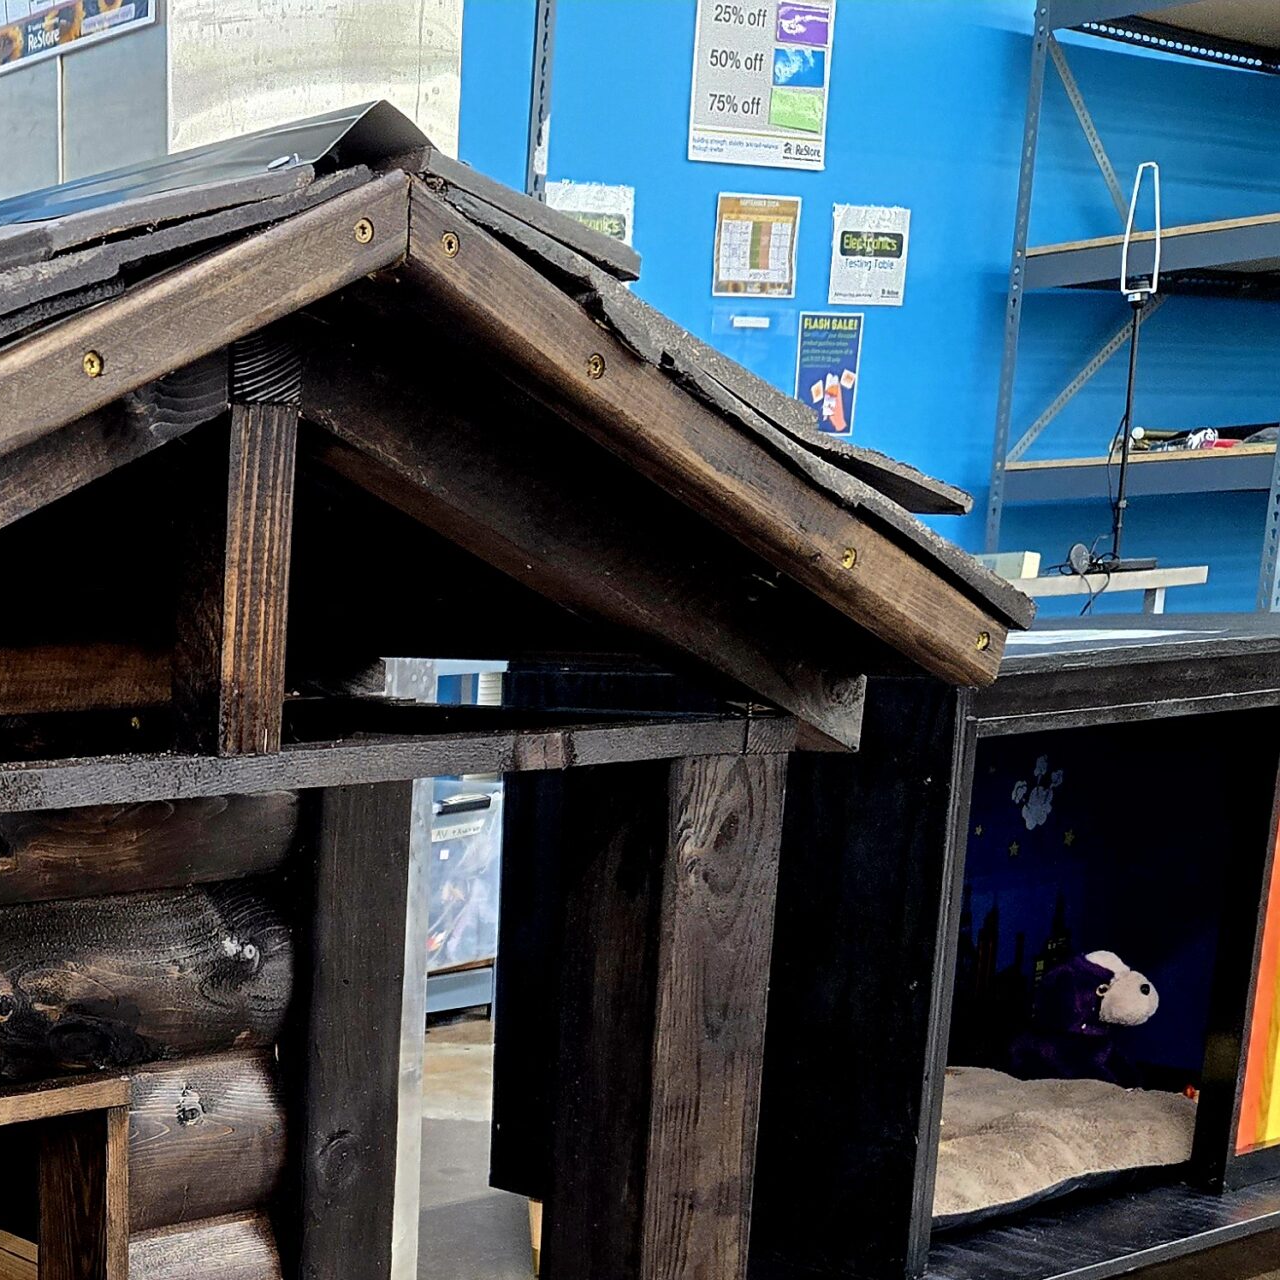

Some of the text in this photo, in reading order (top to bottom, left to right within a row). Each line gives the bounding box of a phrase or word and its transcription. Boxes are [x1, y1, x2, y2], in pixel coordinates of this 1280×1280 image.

[714, 4, 767, 27] 25% off
[27, 28, 61, 52] ReStore
[710, 49, 764, 71] 50% off
[708, 93, 761, 115] 75% off
[843, 233, 898, 251] Electronics
[845, 258, 894, 271] Testing Table
[804, 317, 858, 330] FLASH SALE!
